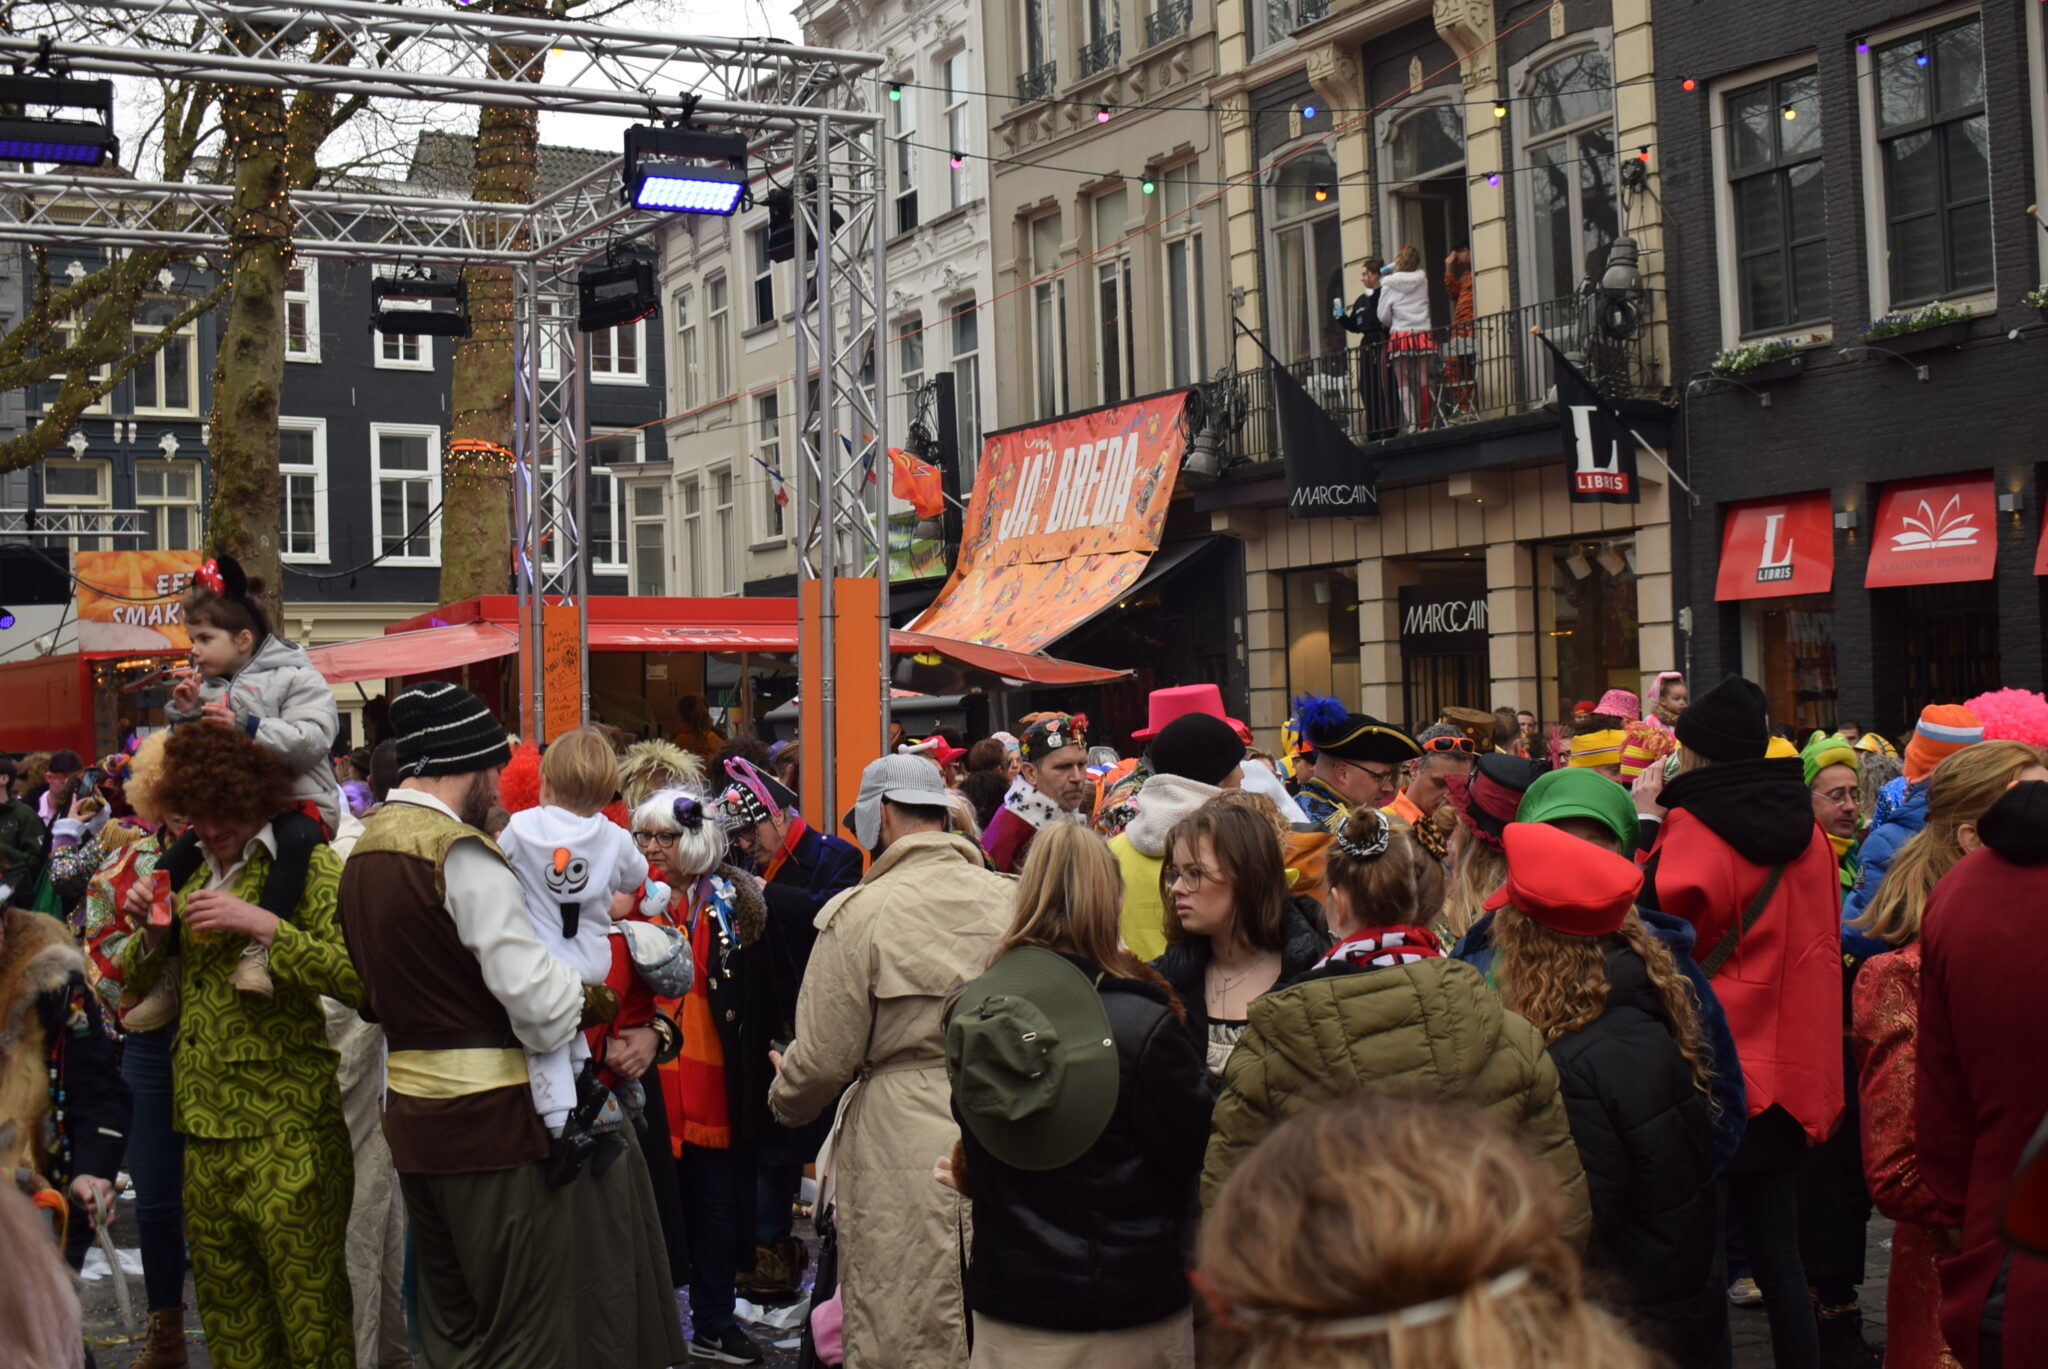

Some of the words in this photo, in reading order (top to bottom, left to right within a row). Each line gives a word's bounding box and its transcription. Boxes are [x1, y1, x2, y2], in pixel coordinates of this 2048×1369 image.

[1043, 432, 1139, 534] BREDA
[1577, 475, 1624, 490] LIBRIS
[1758, 567, 1791, 581] LIBRIS
[112, 602, 186, 626] SMAK
